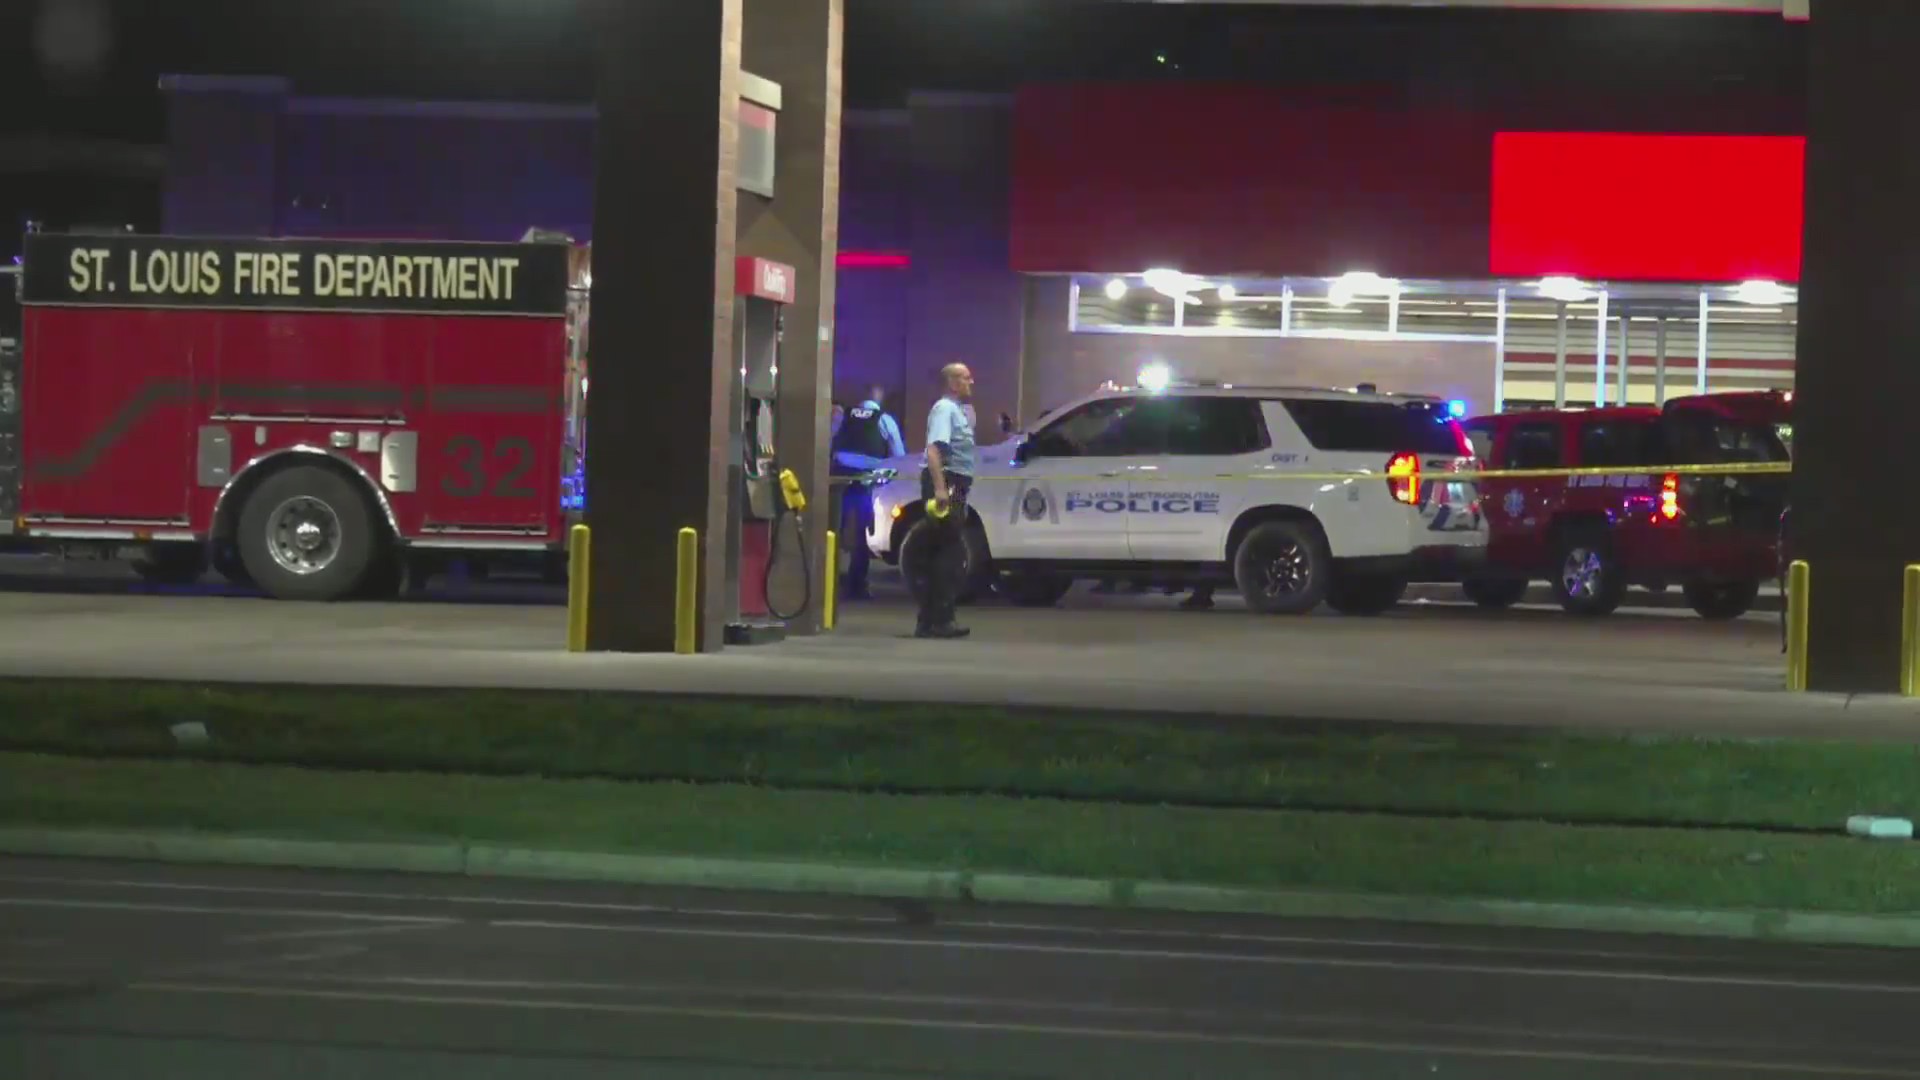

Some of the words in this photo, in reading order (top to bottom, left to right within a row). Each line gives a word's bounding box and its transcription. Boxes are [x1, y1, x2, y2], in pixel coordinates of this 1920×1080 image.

[69, 247, 116, 293] ST.
[129, 248, 221, 295] LOUIS
[233, 251, 300, 296] FIRE
[313, 253, 520, 300] DEPARTMENT
[440, 434, 537, 497] 32
[1065, 499, 1220, 514] POLICE
